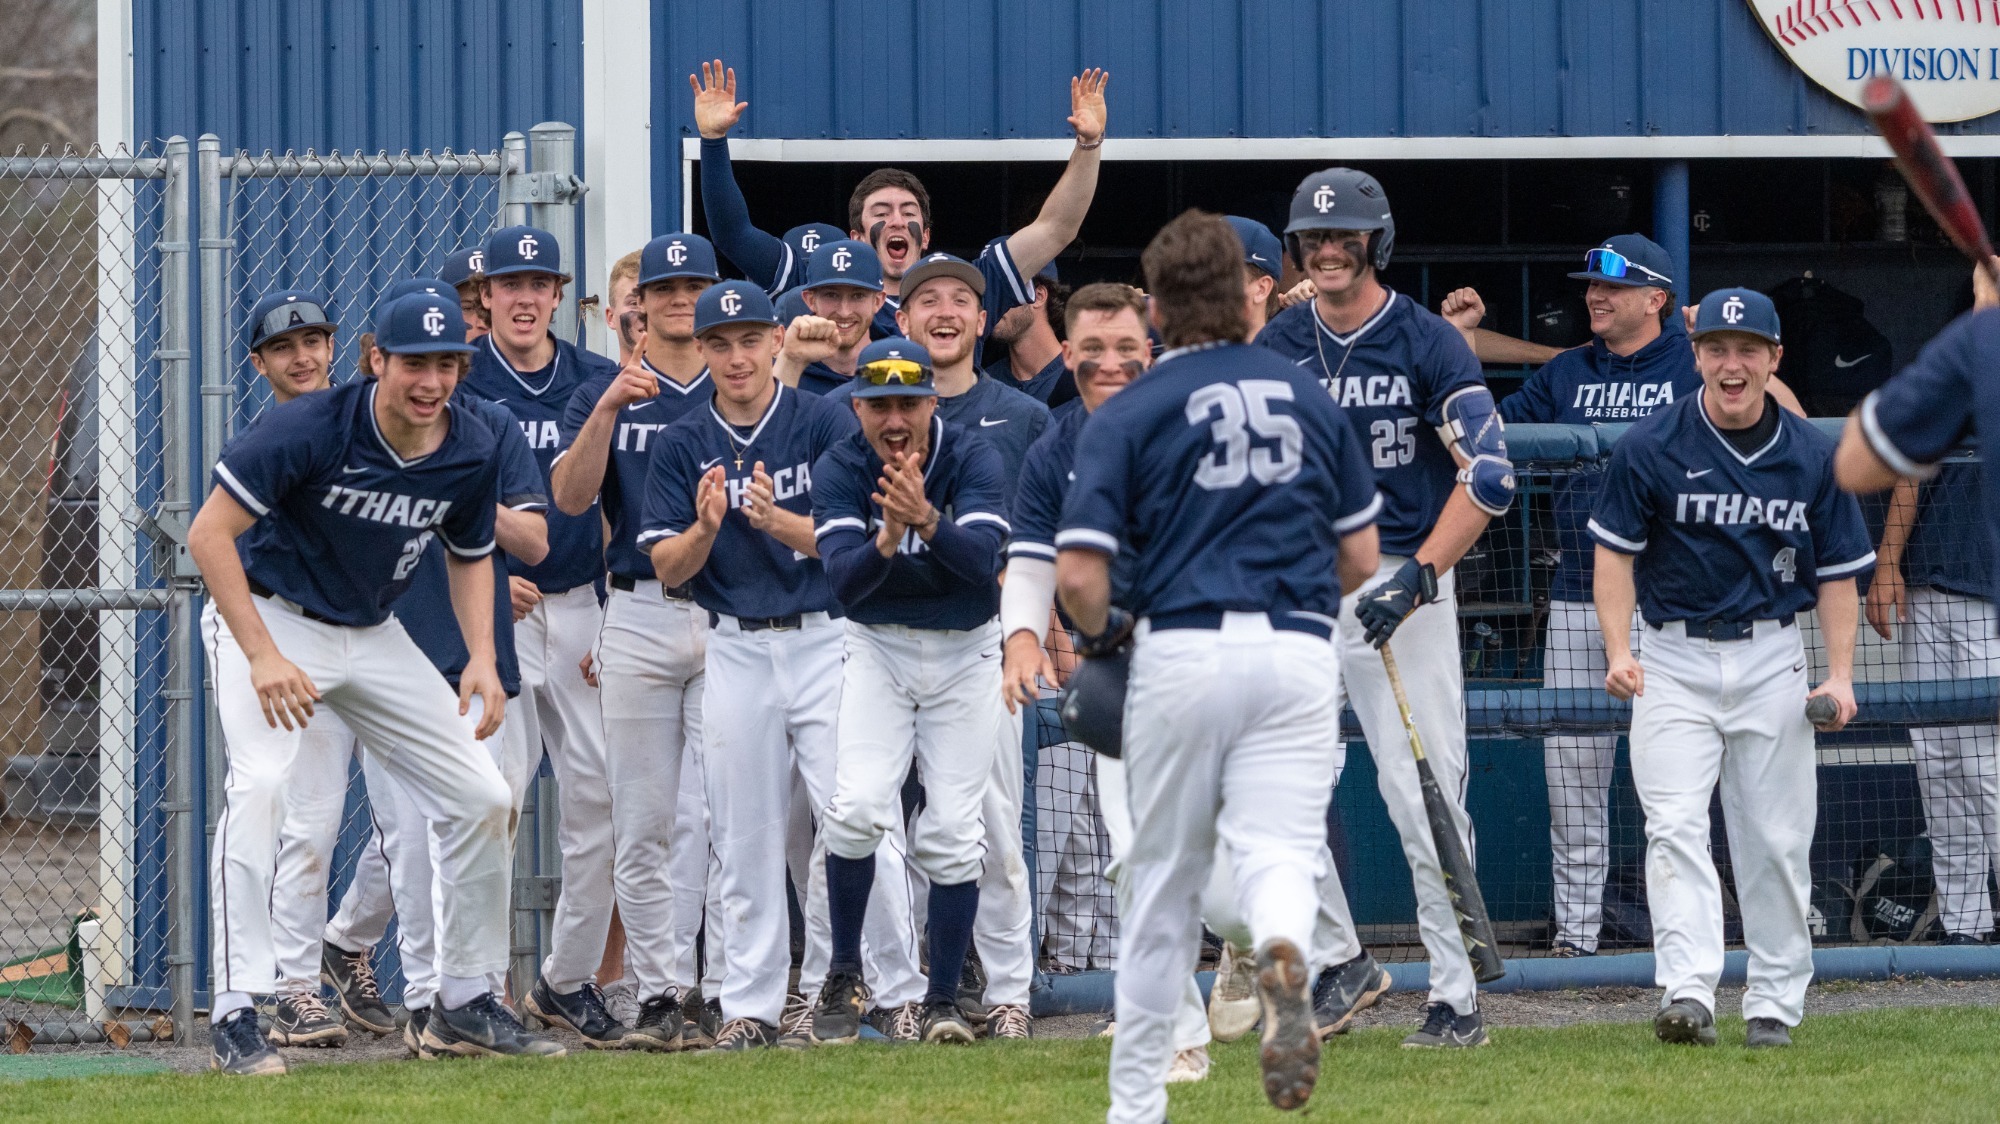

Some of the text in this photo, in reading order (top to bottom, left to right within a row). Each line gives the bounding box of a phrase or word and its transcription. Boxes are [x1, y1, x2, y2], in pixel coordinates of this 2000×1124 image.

[1847, 47, 1980, 81] DIVISION
[1573, 381, 1674, 408] ITHACA
[1585, 407, 1653, 418] BASEBALL
[1185, 379, 1303, 490] 35
[1370, 417, 1418, 468] 25
[321, 485, 452, 528] ITHACA
[1676, 493, 1809, 532] ITHACA
[1772, 547, 1797, 583] 4
